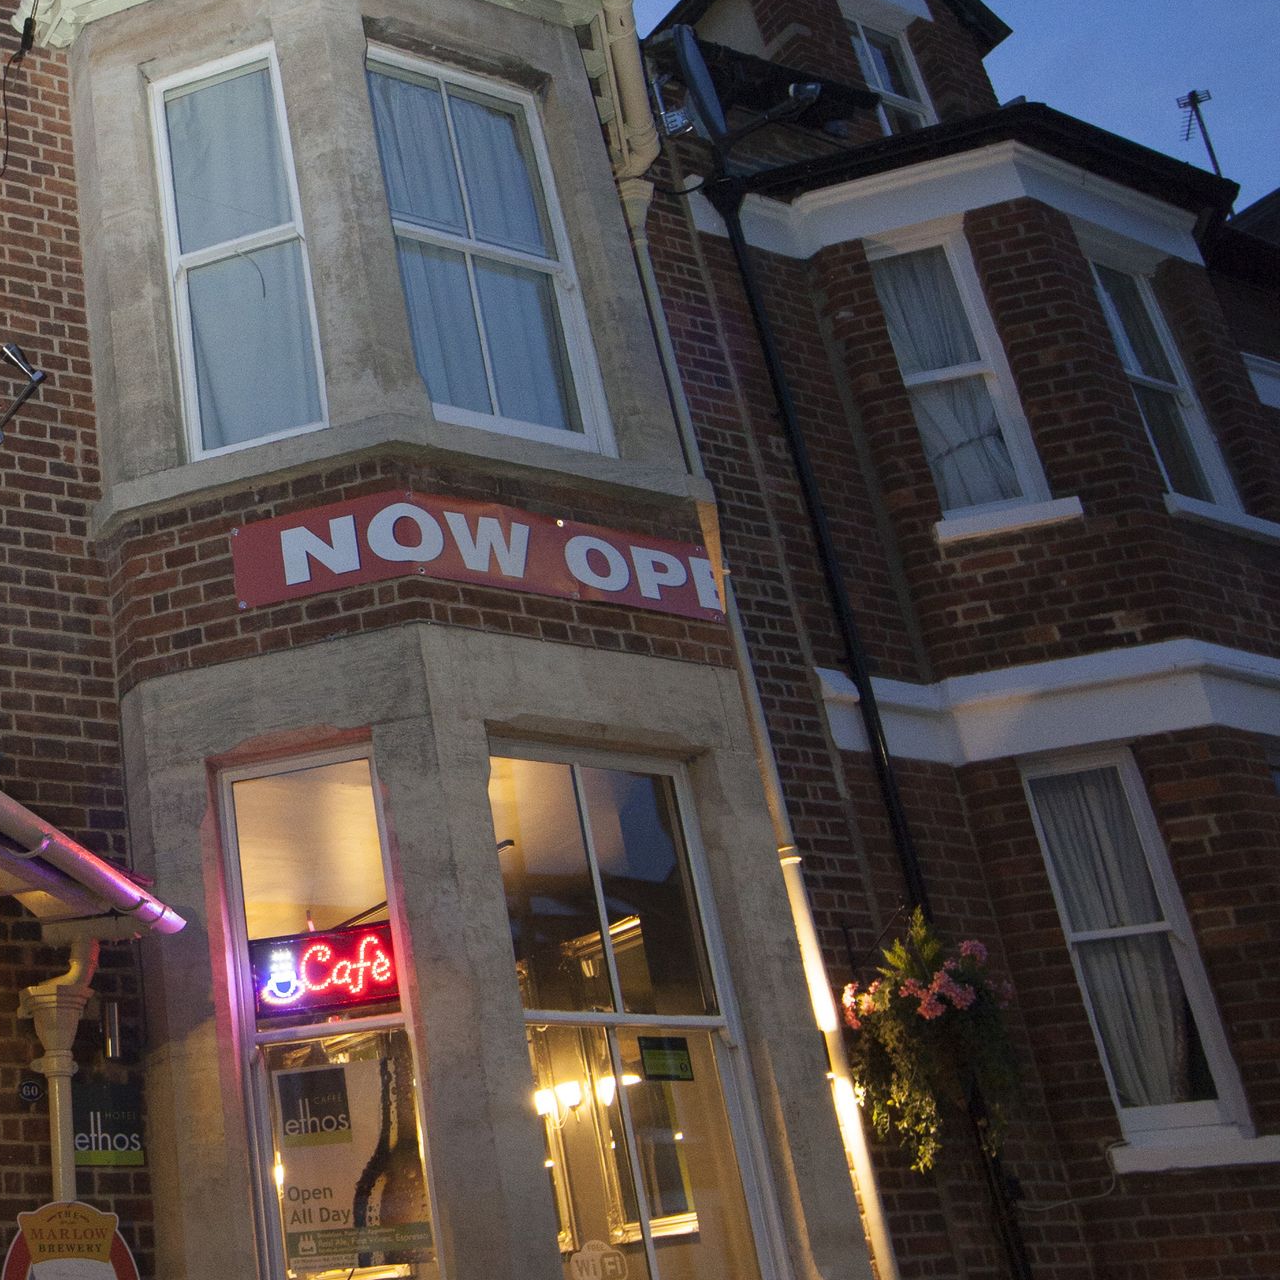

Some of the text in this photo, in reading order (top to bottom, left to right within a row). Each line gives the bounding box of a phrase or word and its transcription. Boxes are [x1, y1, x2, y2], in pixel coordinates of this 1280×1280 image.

[280, 502, 530, 586] NOW
[105, 1111, 137, 1121] HOTEL
[285, 1098, 349, 1135] ethos
[74, 1111, 141, 1151] ethos
[288, 1185, 333, 1204] Open
[290, 1207, 351, 1226] All Day
[30, 1228, 109, 1241] MARLOW
[38, 1243, 103, 1253] BREWERY
